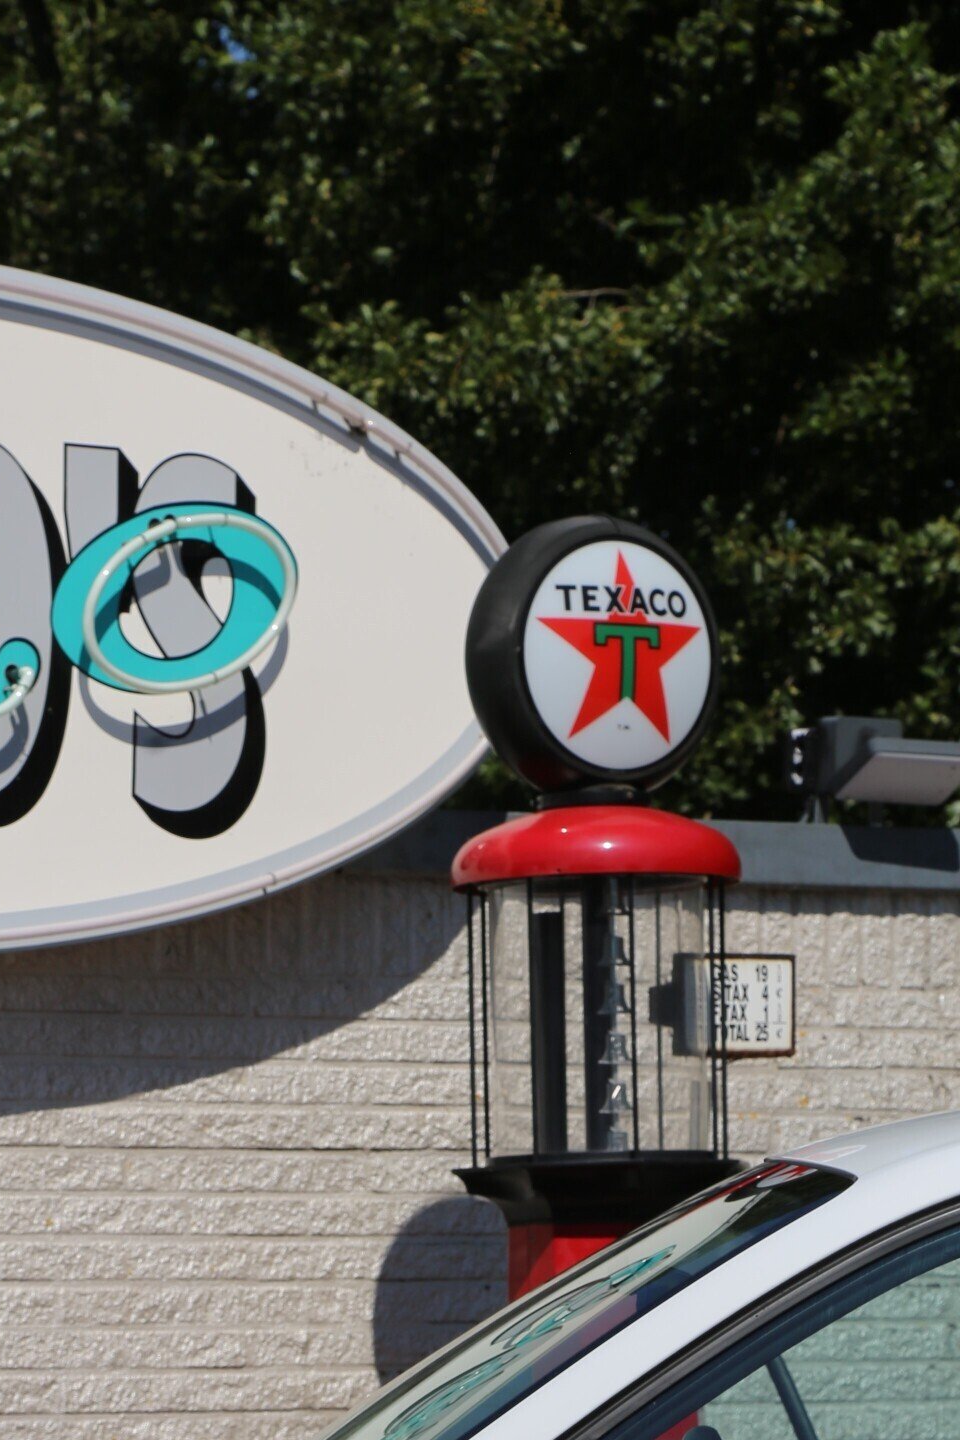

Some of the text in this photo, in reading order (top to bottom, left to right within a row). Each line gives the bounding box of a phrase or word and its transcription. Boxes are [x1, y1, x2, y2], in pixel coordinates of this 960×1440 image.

[555, 584, 687, 618] TEXACO
[594, 622, 661, 703] T
[756, 965, 768, 982] 19
[713, 983, 749, 1001] STAX
[762, 984, 769, 1000] 4
[756, 1023, 769, 1041] 25
